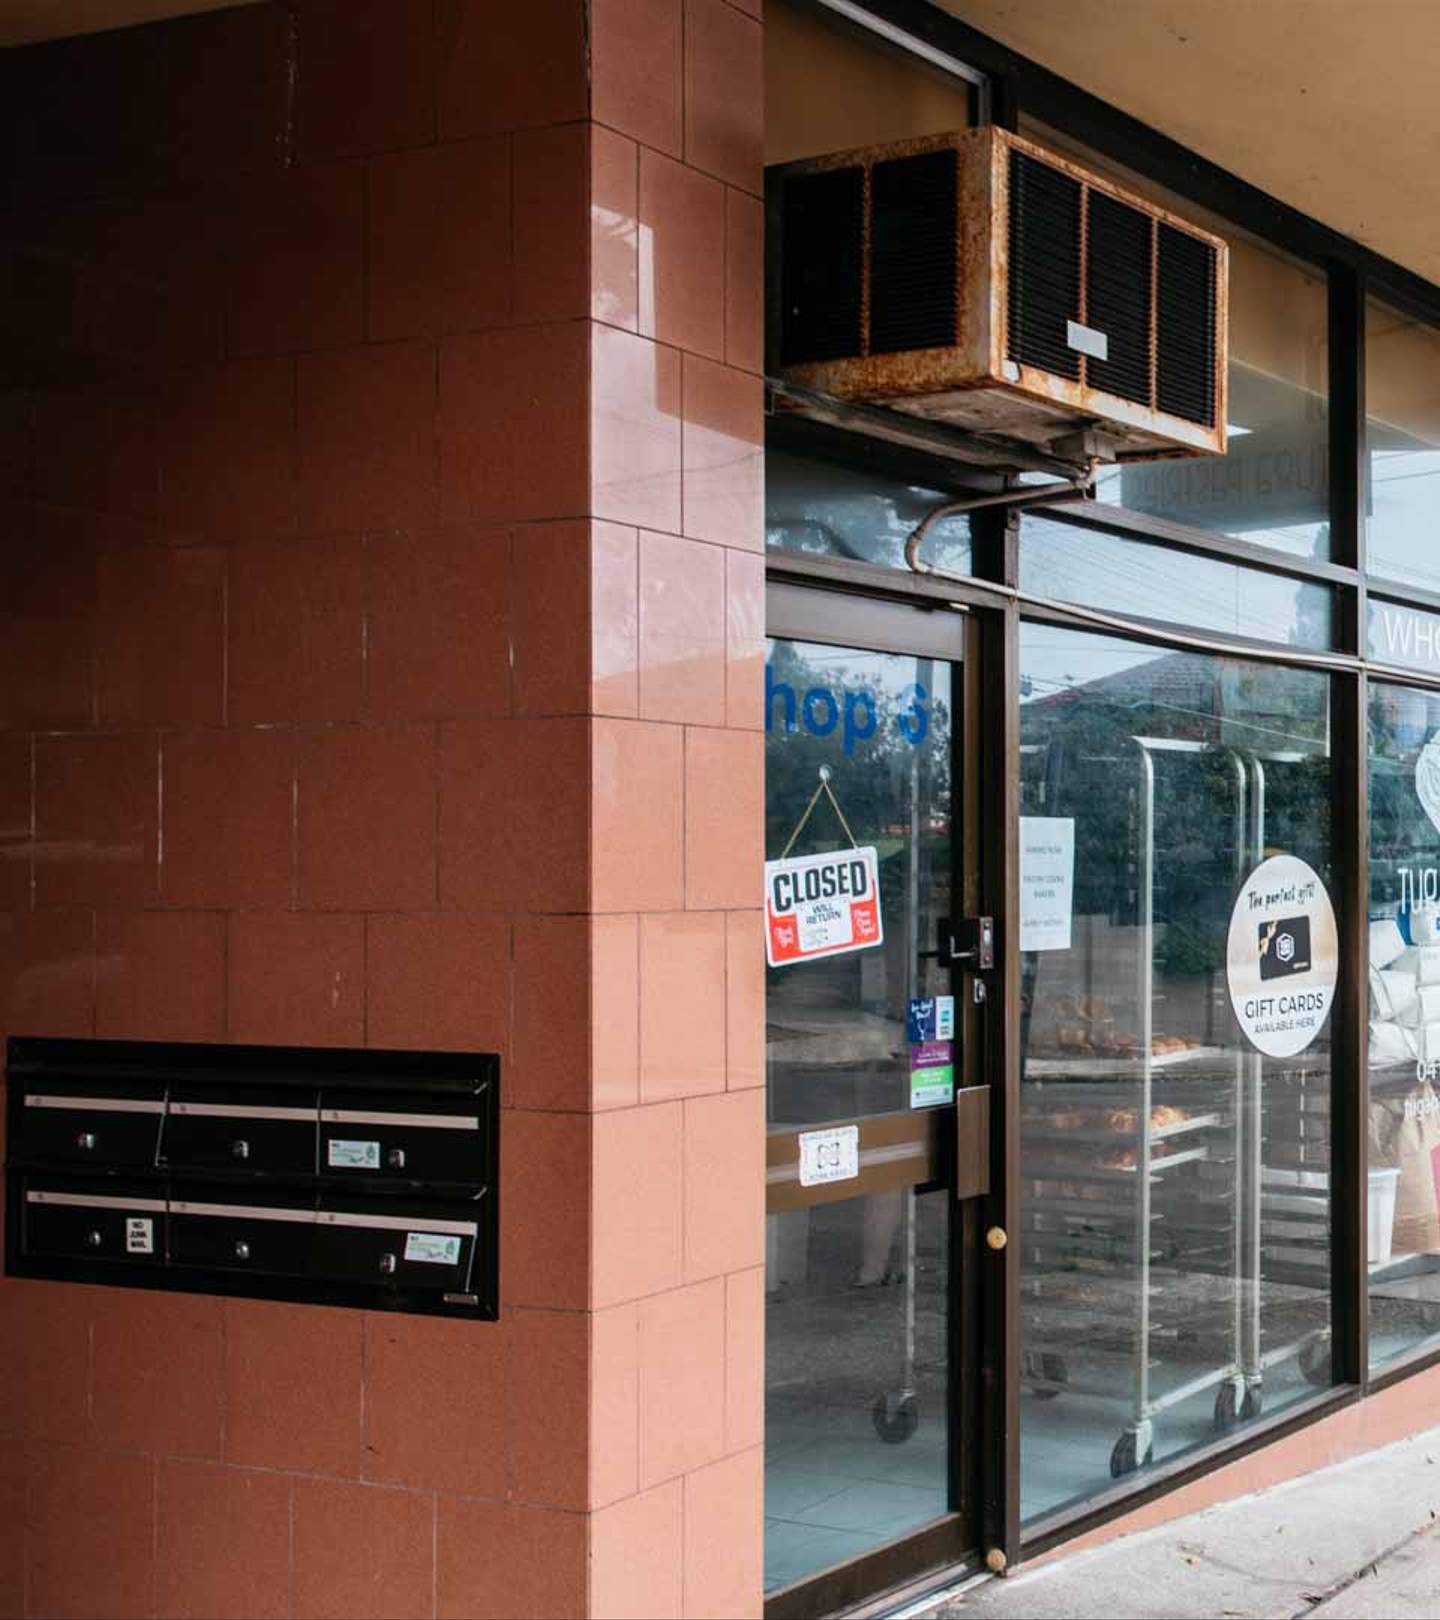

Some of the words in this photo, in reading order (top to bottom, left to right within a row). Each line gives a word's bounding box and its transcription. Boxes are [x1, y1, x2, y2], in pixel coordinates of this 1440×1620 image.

[765, 664, 877, 754] hop
[774, 860, 867, 912] CLOSED
[1248, 891, 1263, 910] The
[1245, 997, 1275, 1019] GIFT
[1278, 993, 1323, 1014] CARDS
[1254, 1019, 1294, 1034] AVAILABLE
[1296, 1016, 1315, 1029] HERE
